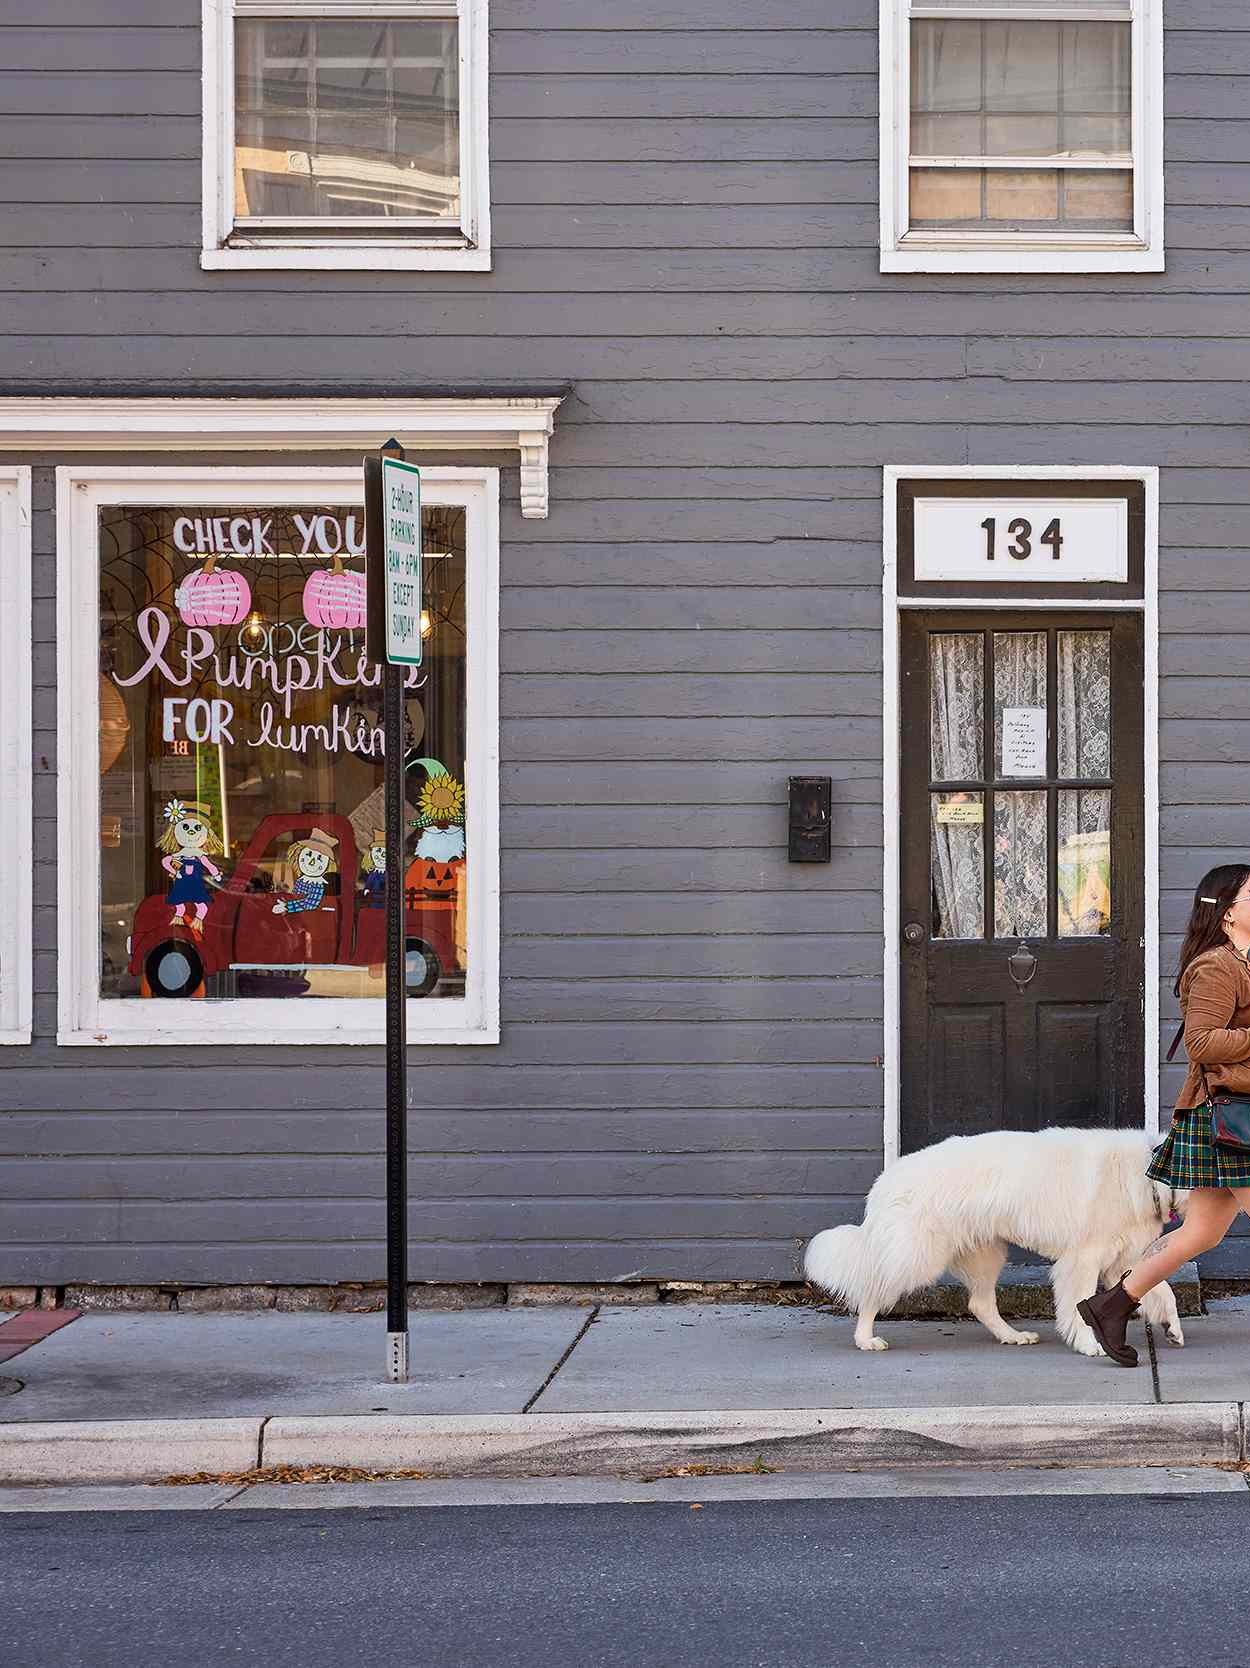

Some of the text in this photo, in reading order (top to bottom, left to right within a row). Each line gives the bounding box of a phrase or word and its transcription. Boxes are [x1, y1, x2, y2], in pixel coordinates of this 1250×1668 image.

[173, 514, 367, 555] CHECK YOU
[391, 519, 415, 545] PARKING
[981, 518, 1063, 560] 134
[393, 581, 414, 607] EXCEPT
[393, 613, 415, 638] SUNDAY
[162, 697, 234, 745] FOR
